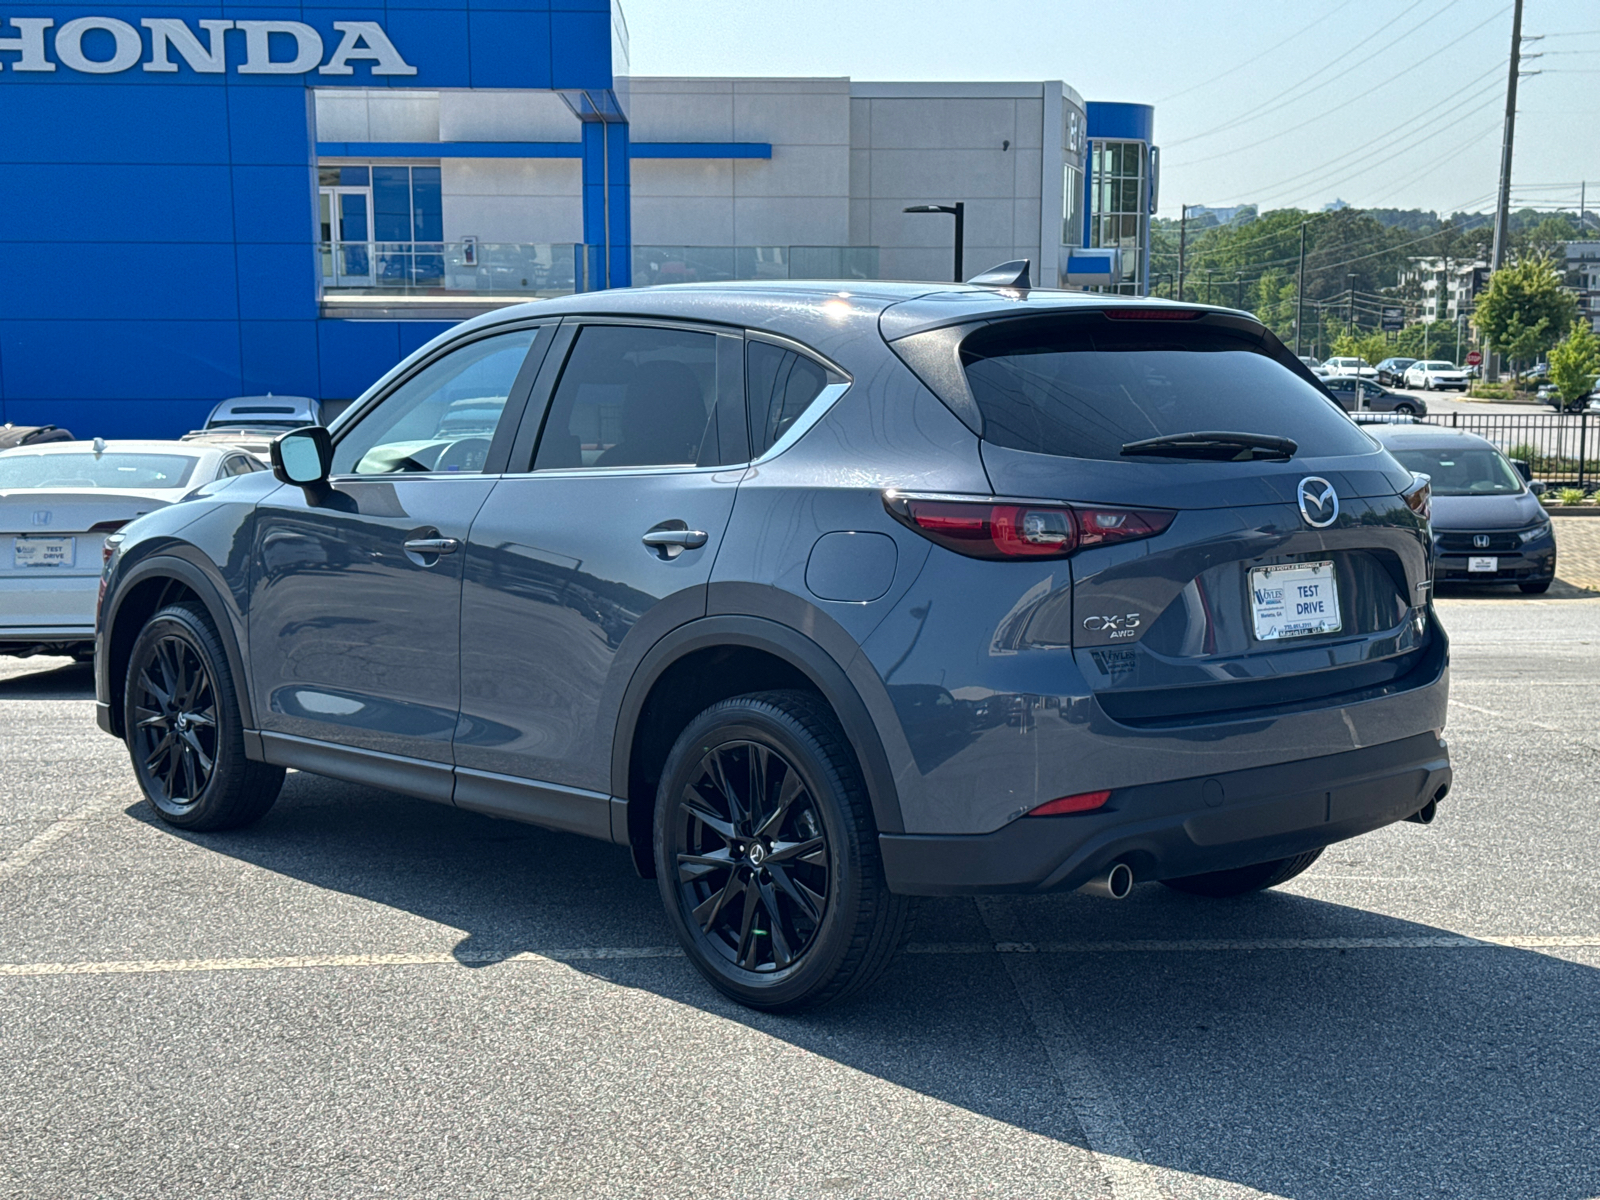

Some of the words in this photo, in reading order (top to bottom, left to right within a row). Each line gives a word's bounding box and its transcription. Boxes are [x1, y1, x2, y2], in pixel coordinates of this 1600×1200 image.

[0, 16, 418, 76] HONDA
[1297, 585, 1319, 598] TEST
[1296, 601, 1325, 615] DRIVE
[1083, 613, 1141, 631] CX-5
[1110, 629, 1135, 638] AWD
